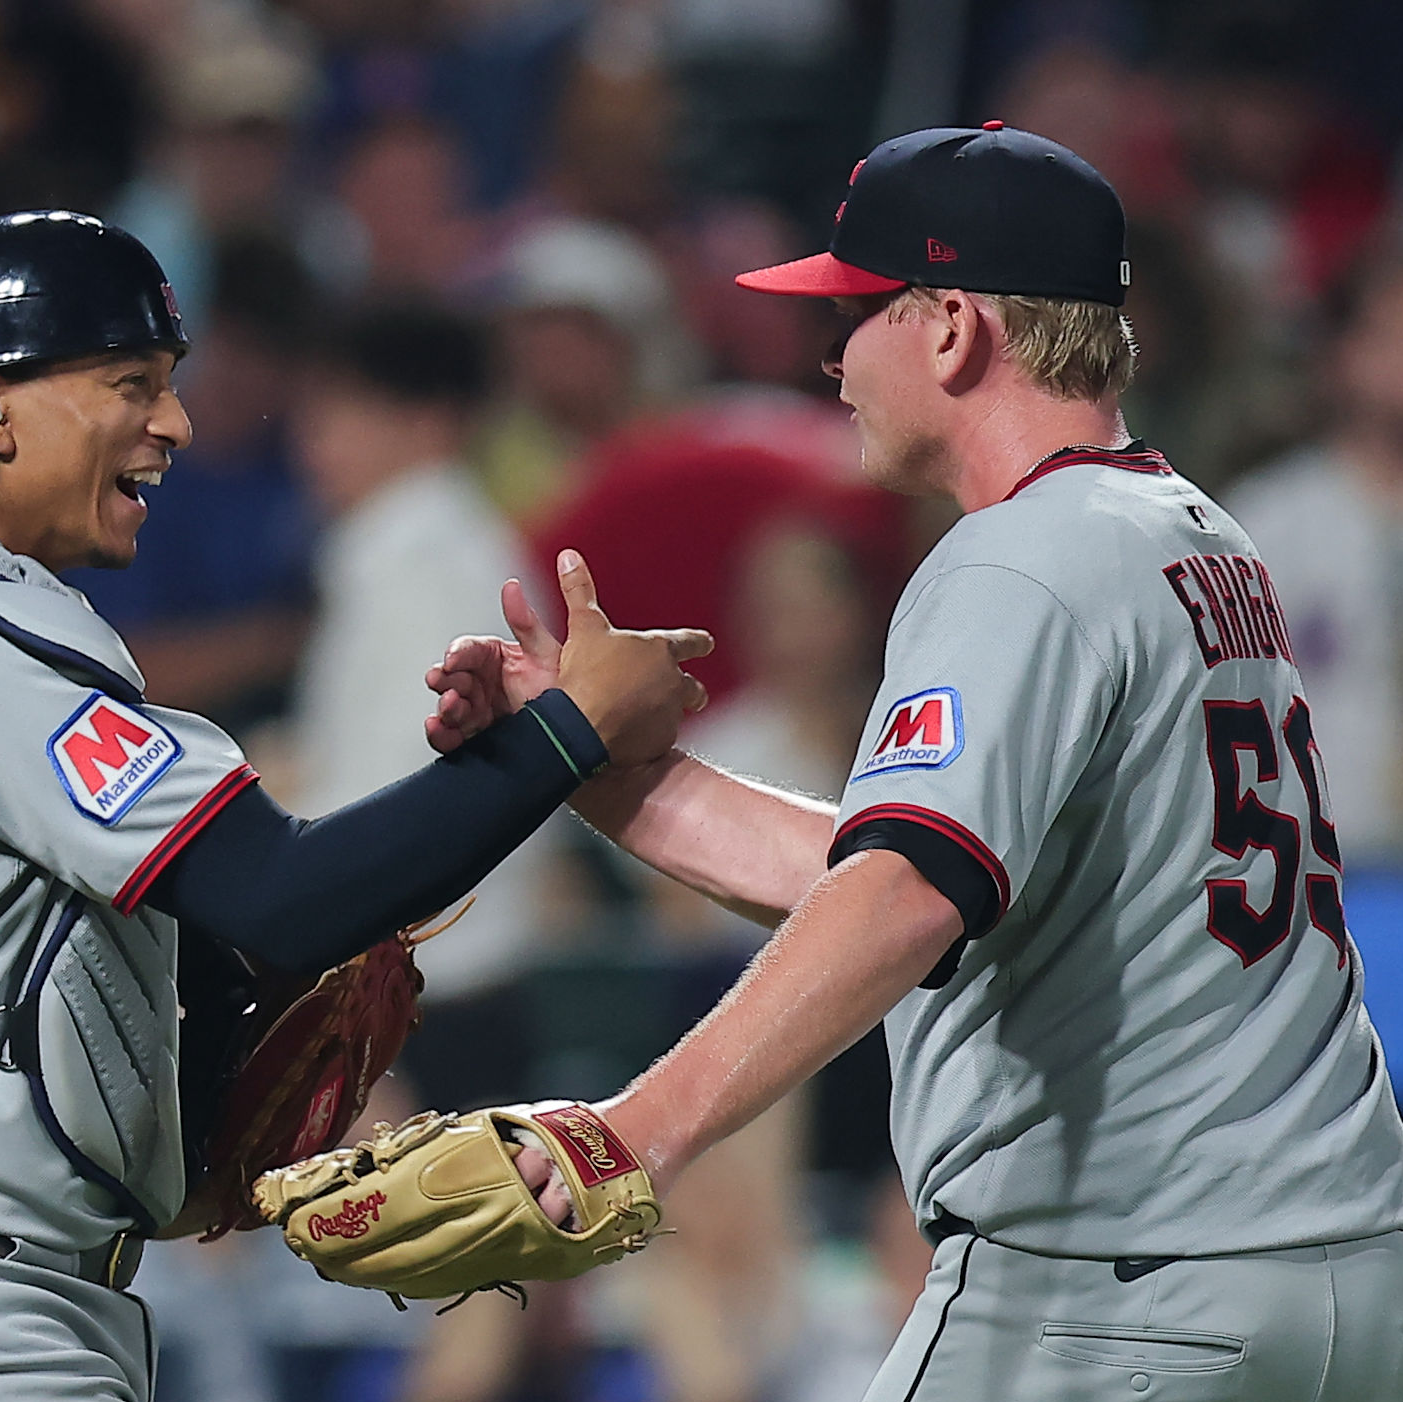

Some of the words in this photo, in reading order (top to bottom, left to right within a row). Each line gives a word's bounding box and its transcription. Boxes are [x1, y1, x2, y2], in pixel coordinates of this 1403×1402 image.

[1161, 555, 1298, 670] ENRIGH
[62, 705, 152, 796] M
[95, 739, 169, 812] Marathon
